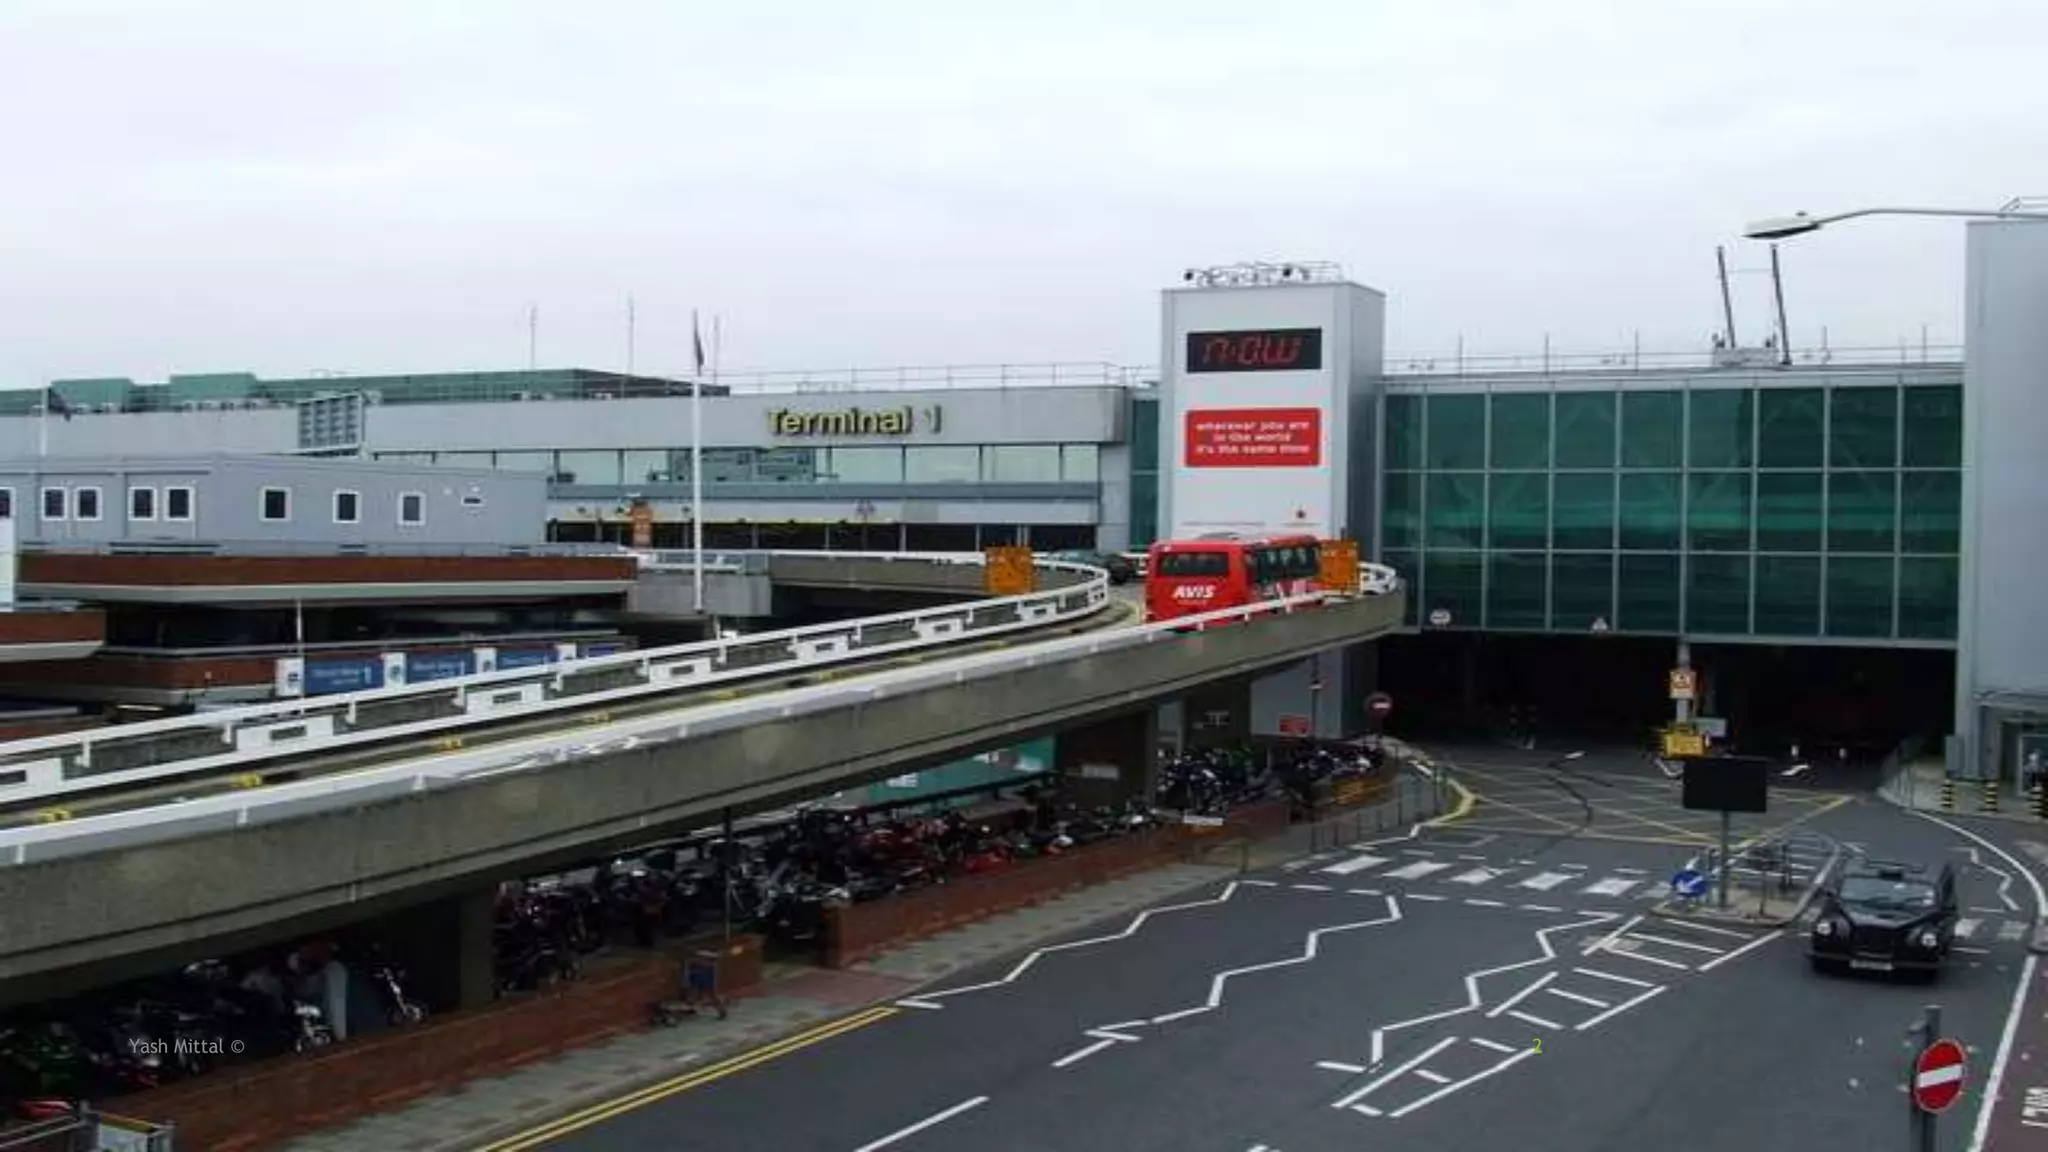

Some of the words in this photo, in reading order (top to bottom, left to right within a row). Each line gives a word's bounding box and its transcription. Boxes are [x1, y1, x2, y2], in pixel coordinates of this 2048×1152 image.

[768, 406, 912, 435] Terminal
[925, 405, 942, 433] 1
[1172, 585, 1216, 599] AVIS
